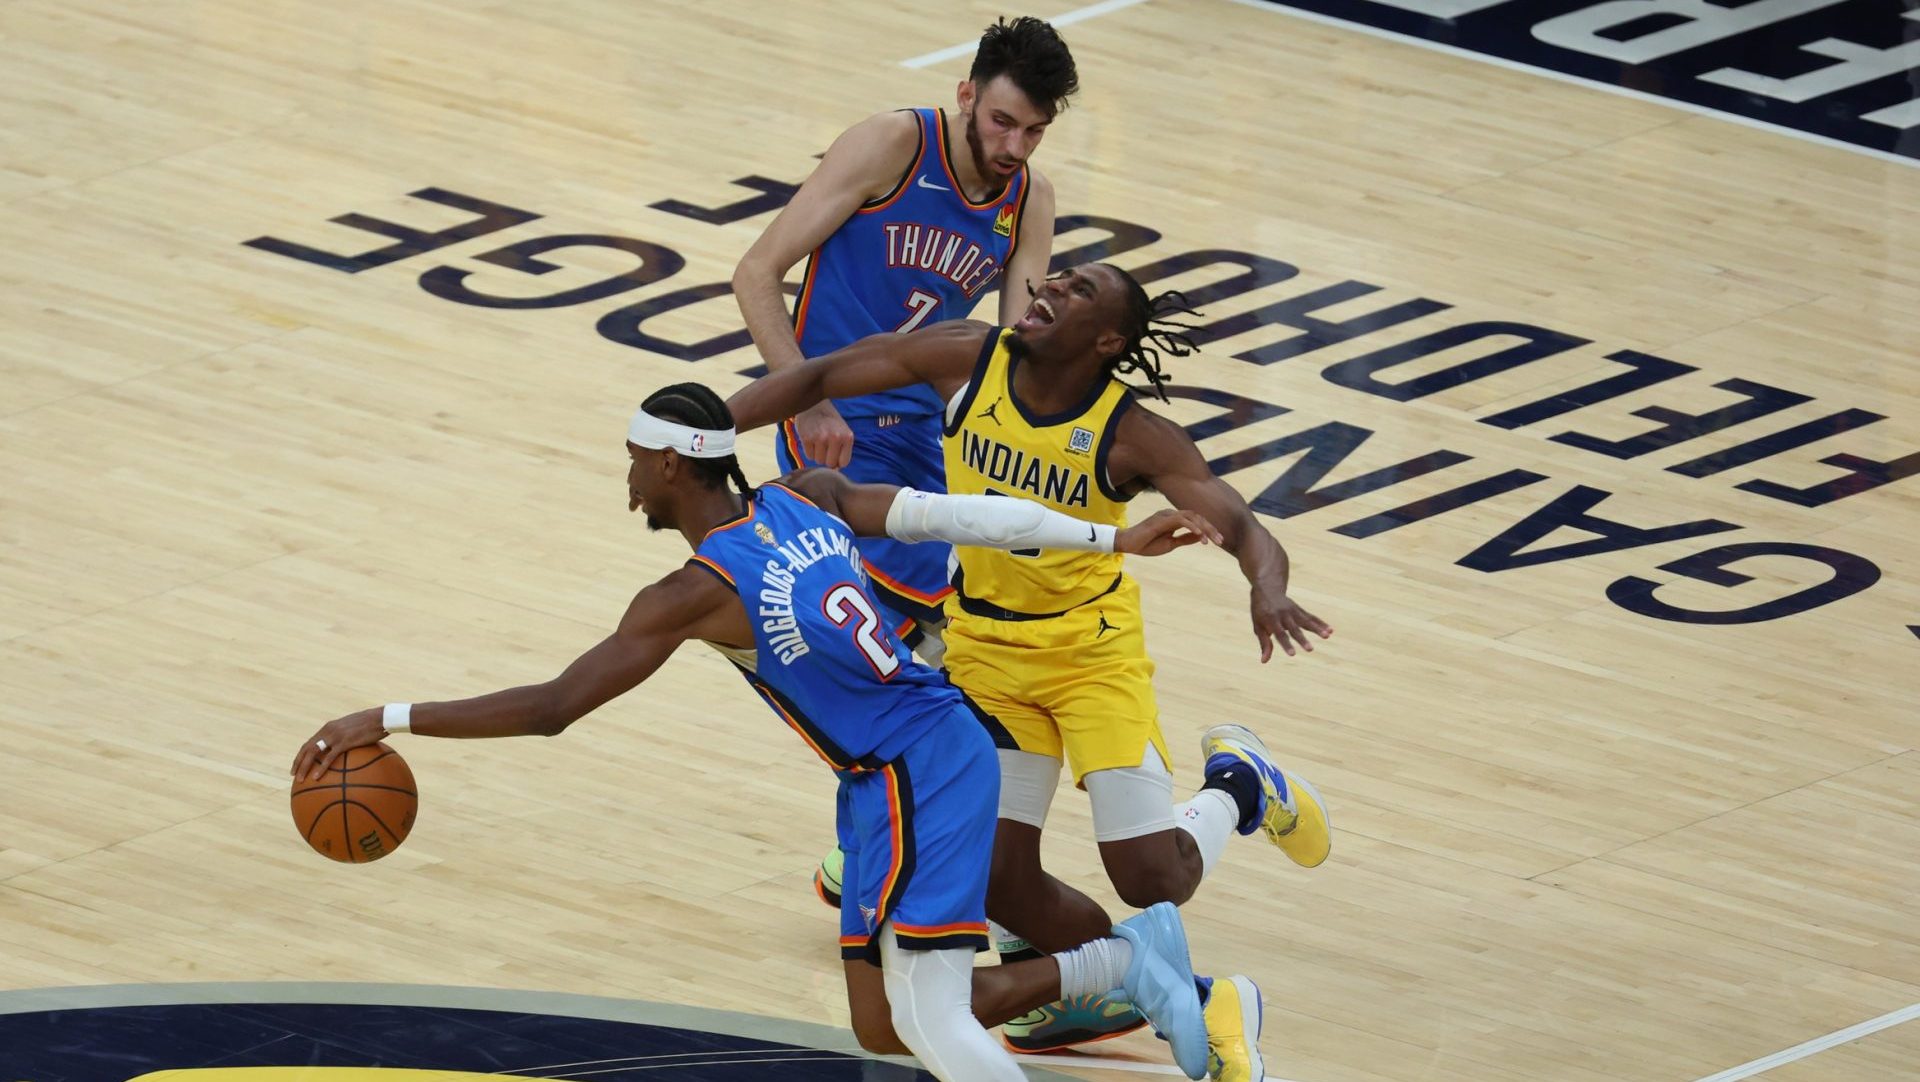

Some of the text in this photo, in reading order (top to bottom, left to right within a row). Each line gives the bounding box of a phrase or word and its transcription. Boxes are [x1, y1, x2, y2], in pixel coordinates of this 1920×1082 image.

[885, 224, 1004, 298] THUNDER
[647, 152, 1920, 508] FIELDHOU
[241, 186, 1881, 625] GAINDGE
[962, 428, 1090, 508] INDIANA
[822, 582, 901, 683] 2
